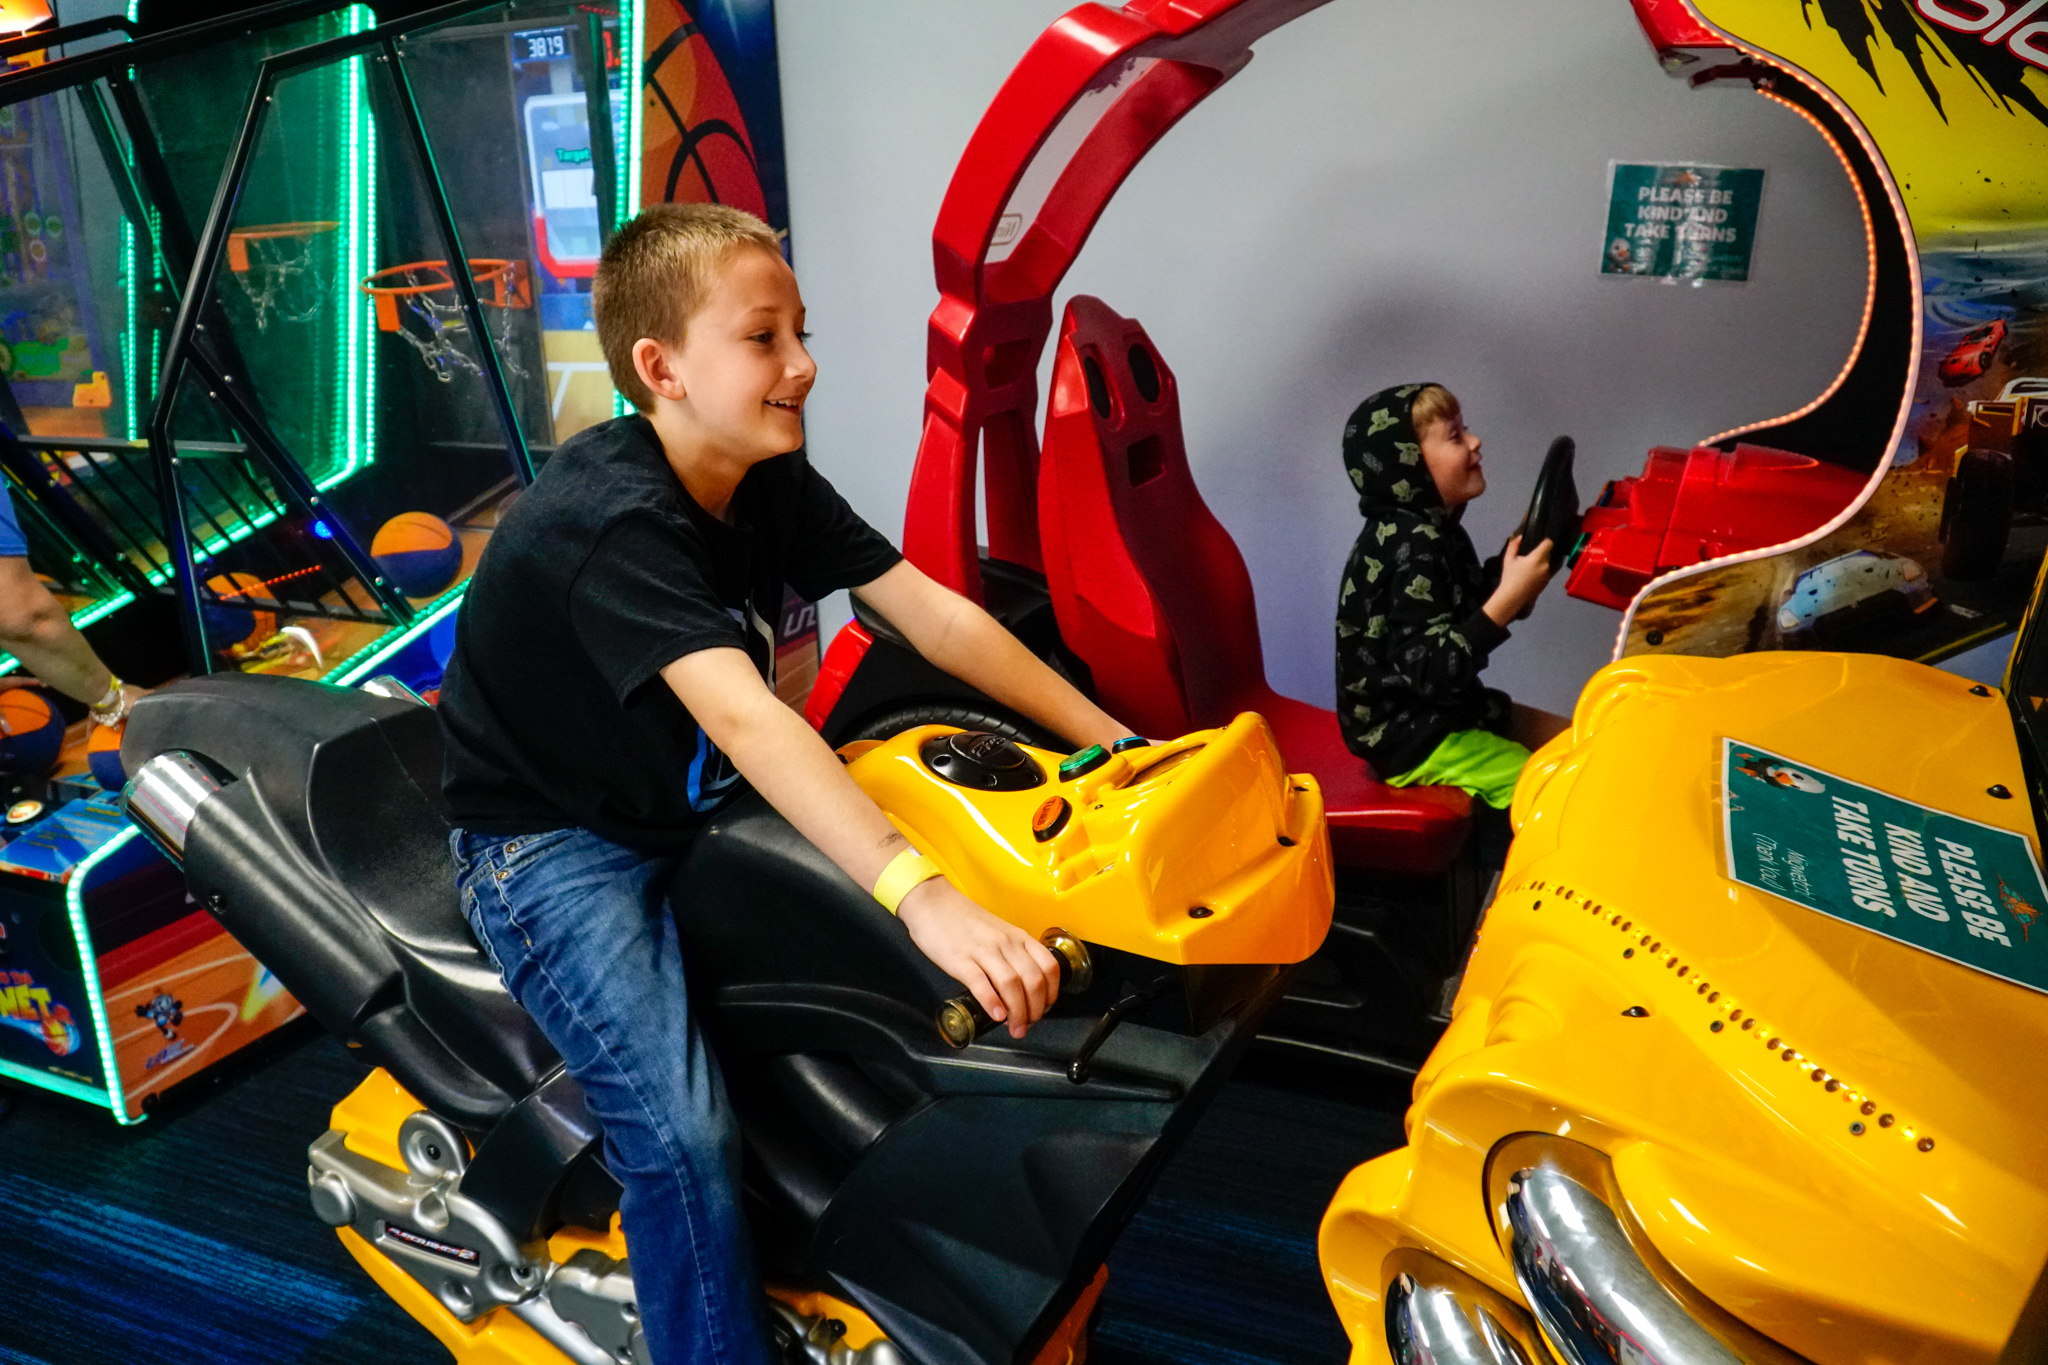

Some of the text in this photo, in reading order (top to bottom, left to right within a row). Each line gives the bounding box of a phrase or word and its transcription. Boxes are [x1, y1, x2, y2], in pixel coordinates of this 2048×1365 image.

[528, 35, 564, 58] 3819
[1638, 186, 1733, 205] PLEASE BE
[1637, 205, 1728, 224] KIND AND
[1624, 223, 1671, 239] TAKE
[1832, 795, 1897, 918] TAKE TURNS
[1884, 822, 1950, 922] KIND AND
[1934, 836, 2012, 948] PLEASE BE
